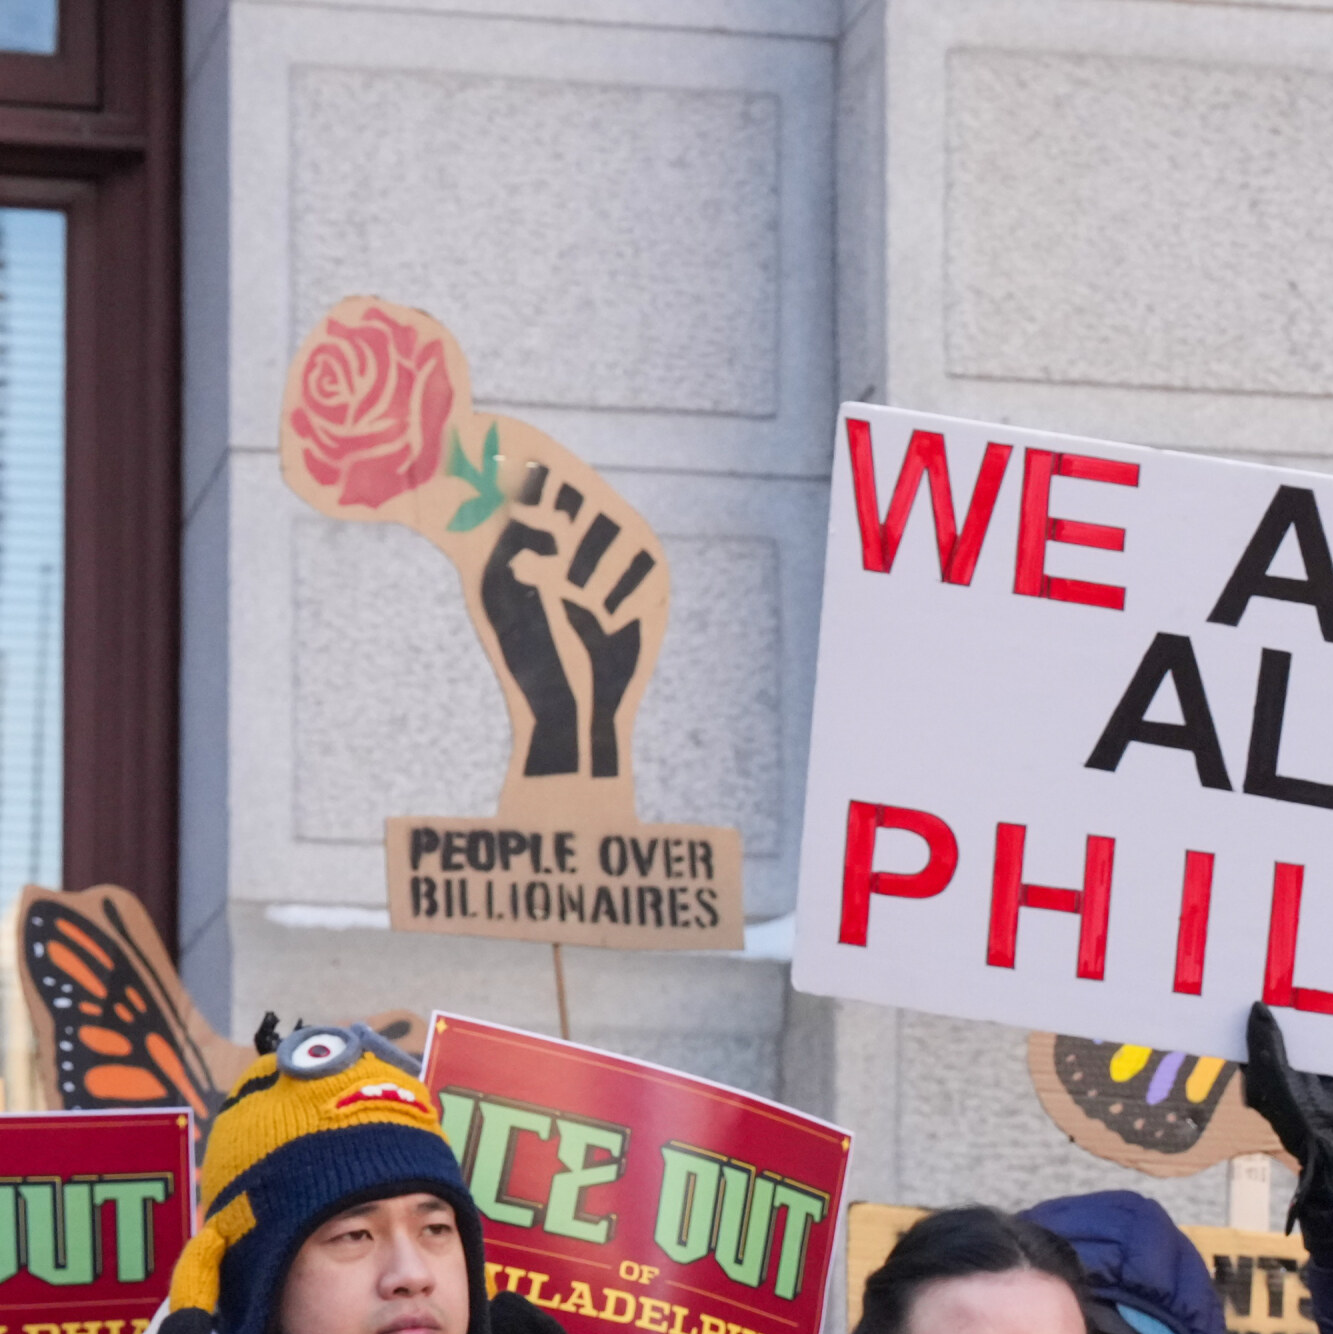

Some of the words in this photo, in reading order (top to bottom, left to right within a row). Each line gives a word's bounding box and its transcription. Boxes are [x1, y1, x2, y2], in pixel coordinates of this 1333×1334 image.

[845, 417, 1140, 611] WE
[410, 827, 578, 876] PEOPLE
[600, 835, 716, 882] OVER
[410, 876, 720, 929] BILLIONAIRES
[653, 1140, 831, 1301] OUT
[618, 1260, 661, 1286] OF
